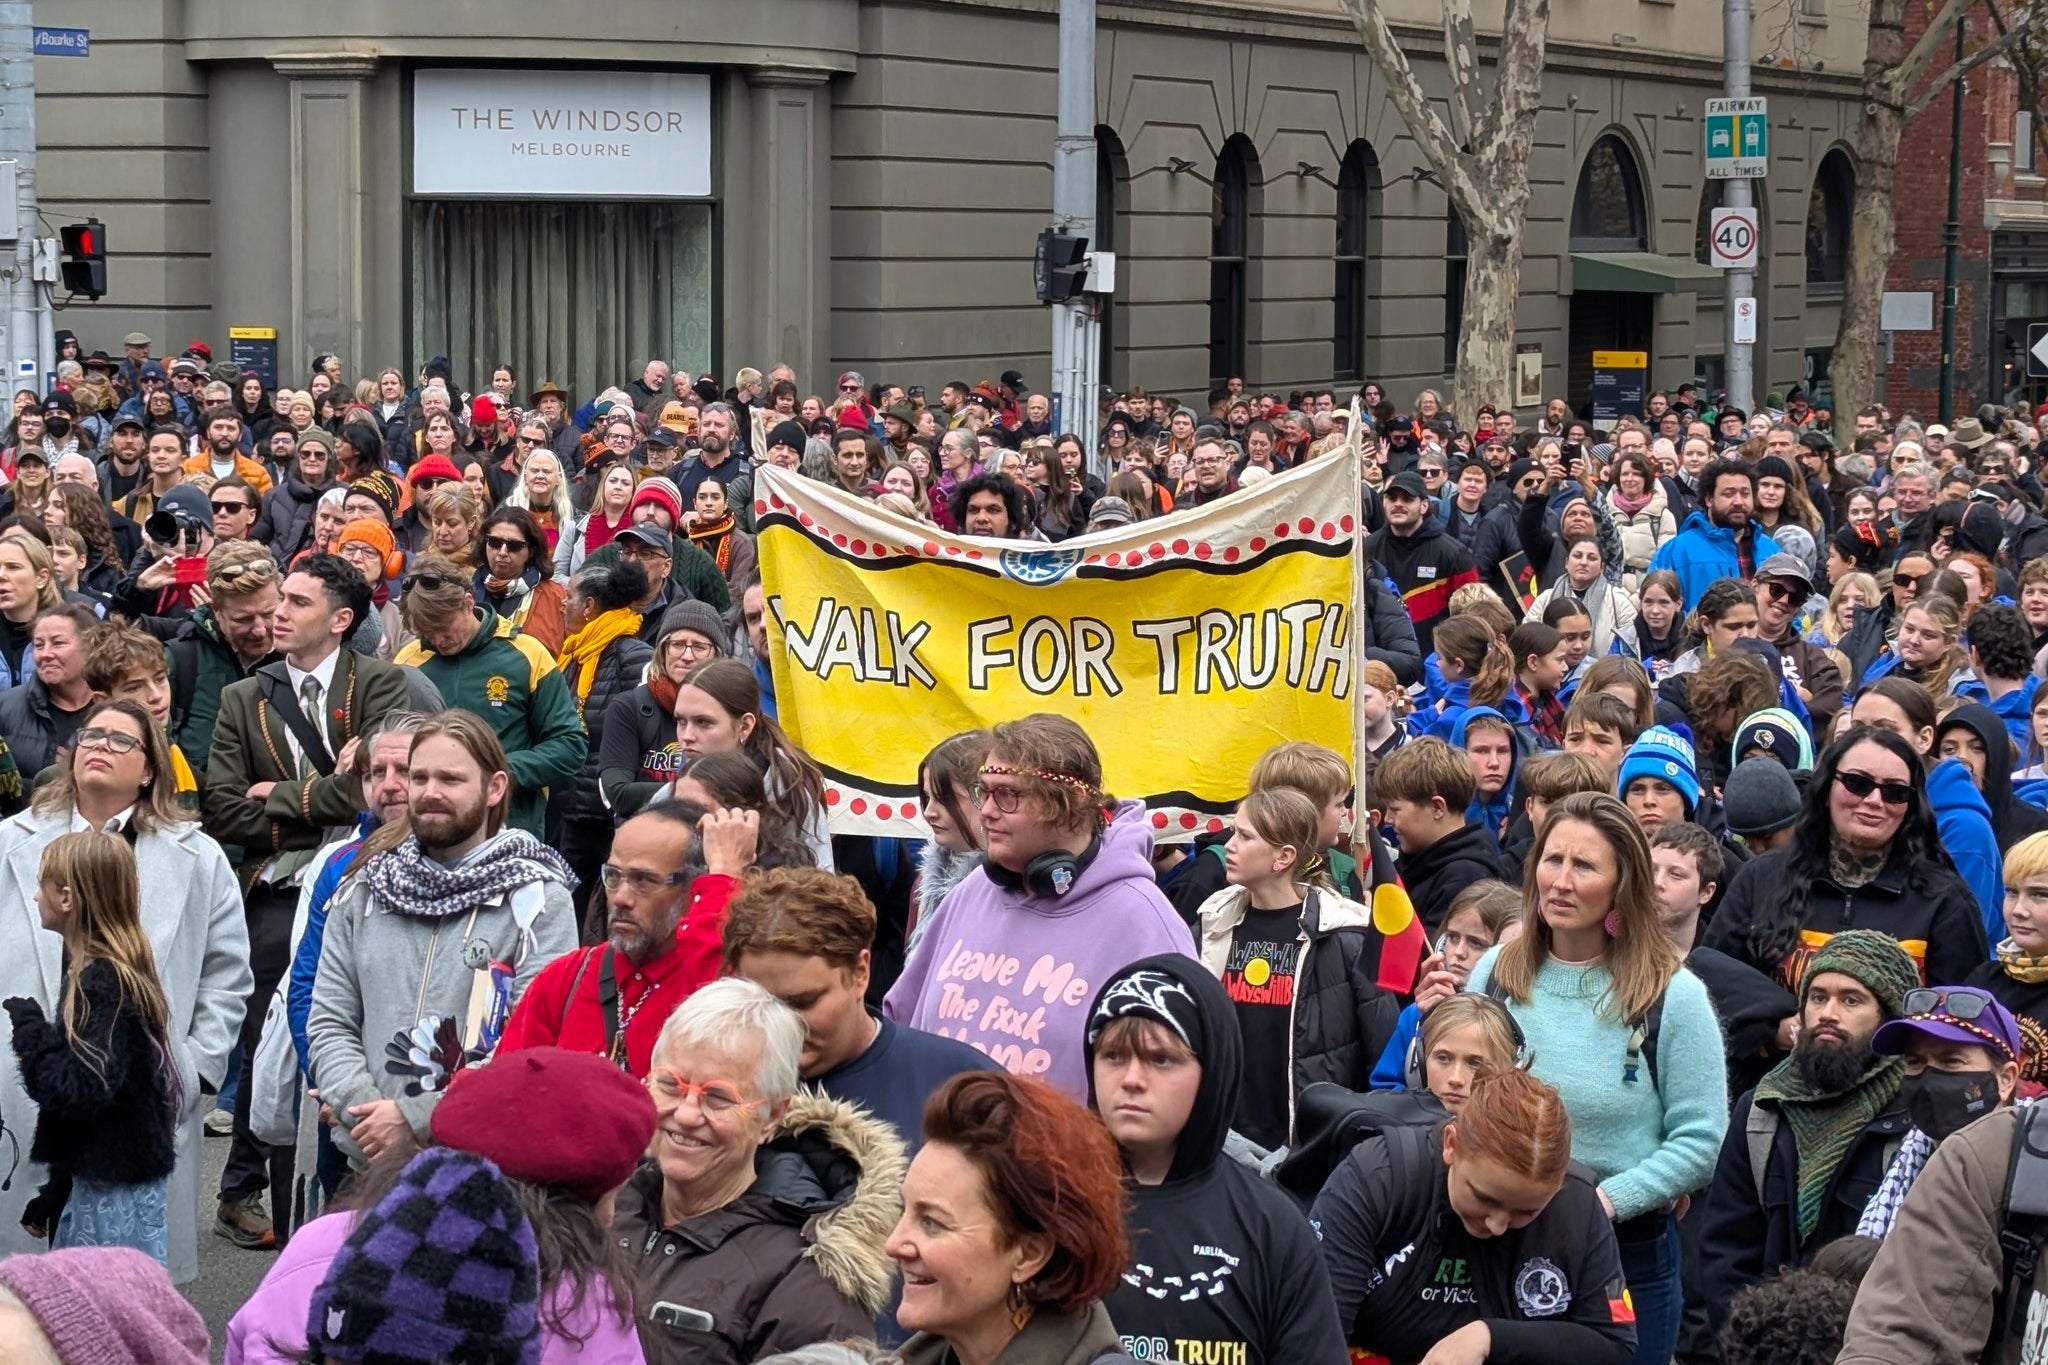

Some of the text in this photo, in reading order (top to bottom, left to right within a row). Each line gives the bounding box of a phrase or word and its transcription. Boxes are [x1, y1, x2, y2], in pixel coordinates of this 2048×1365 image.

[41, 31, 88, 48] Bourke St
[1709, 100, 1761, 112] FAIRWAY
[451, 108, 683, 133] THE WINDSOR
[511, 142, 631, 157] MELBOURNE
[1708, 166, 1764, 177] ALL TIMES
[1716, 226, 1750, 249] 40
[666, 413, 685, 421] DEADLY
[767, 596, 1350, 699] WALK FOR TRUTH
[643, 750, 683, 772] TRE
[936, 938, 1089, 1006] Leave Me
[938, 982, 1046, 1045] The Fxxk
[1119, 1335, 1247, 1365] FOR TRUTH
